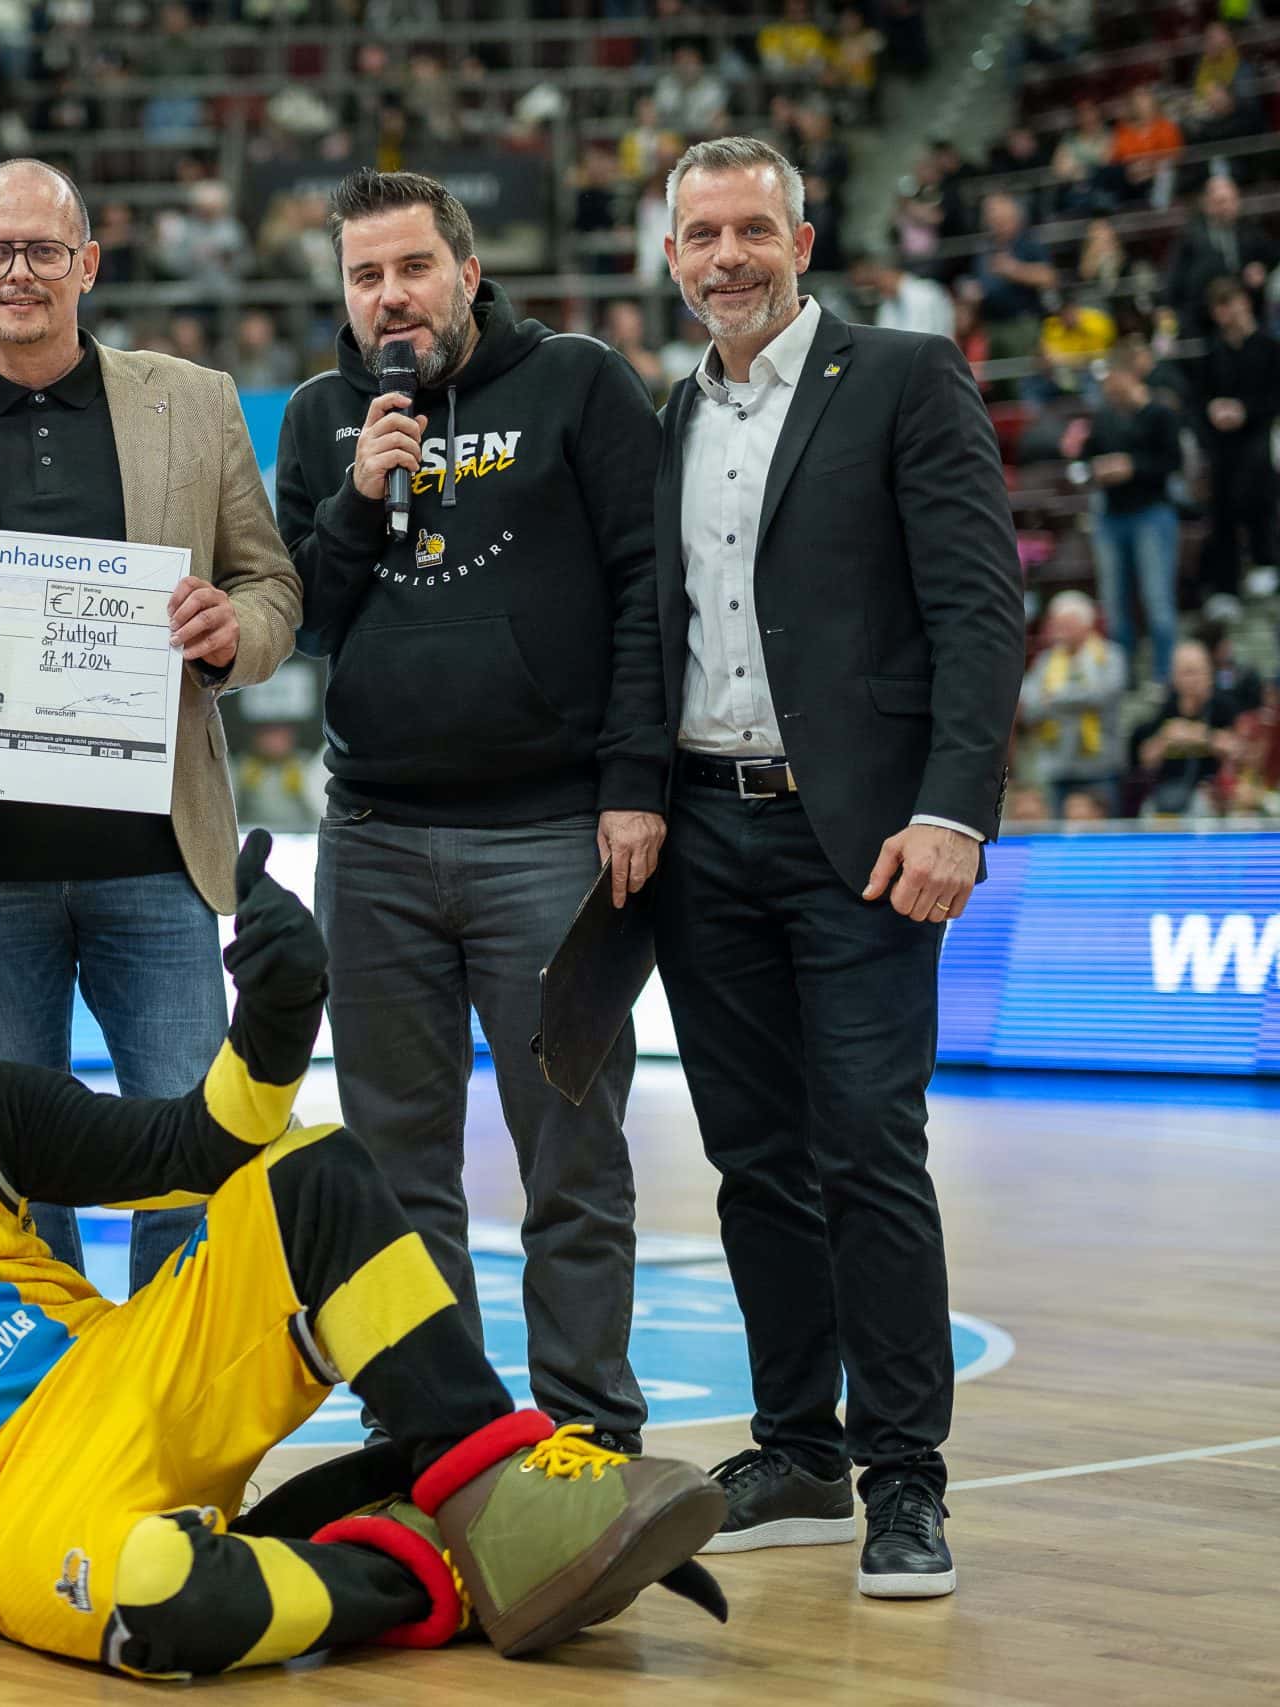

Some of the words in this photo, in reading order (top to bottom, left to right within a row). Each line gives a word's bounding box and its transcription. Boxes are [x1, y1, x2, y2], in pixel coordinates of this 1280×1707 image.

[335, 427, 362, 442] mac
[421, 431, 521, 472] SEN
[98, 556, 127, 574] eG
[49, 592, 73, 615] €
[81, 596, 145, 620] 2.000,-
[44, 621, 119, 650] Stuttgart
[39, 664, 63, 673] Datum
[35, 707, 77, 718] Unterschrift
